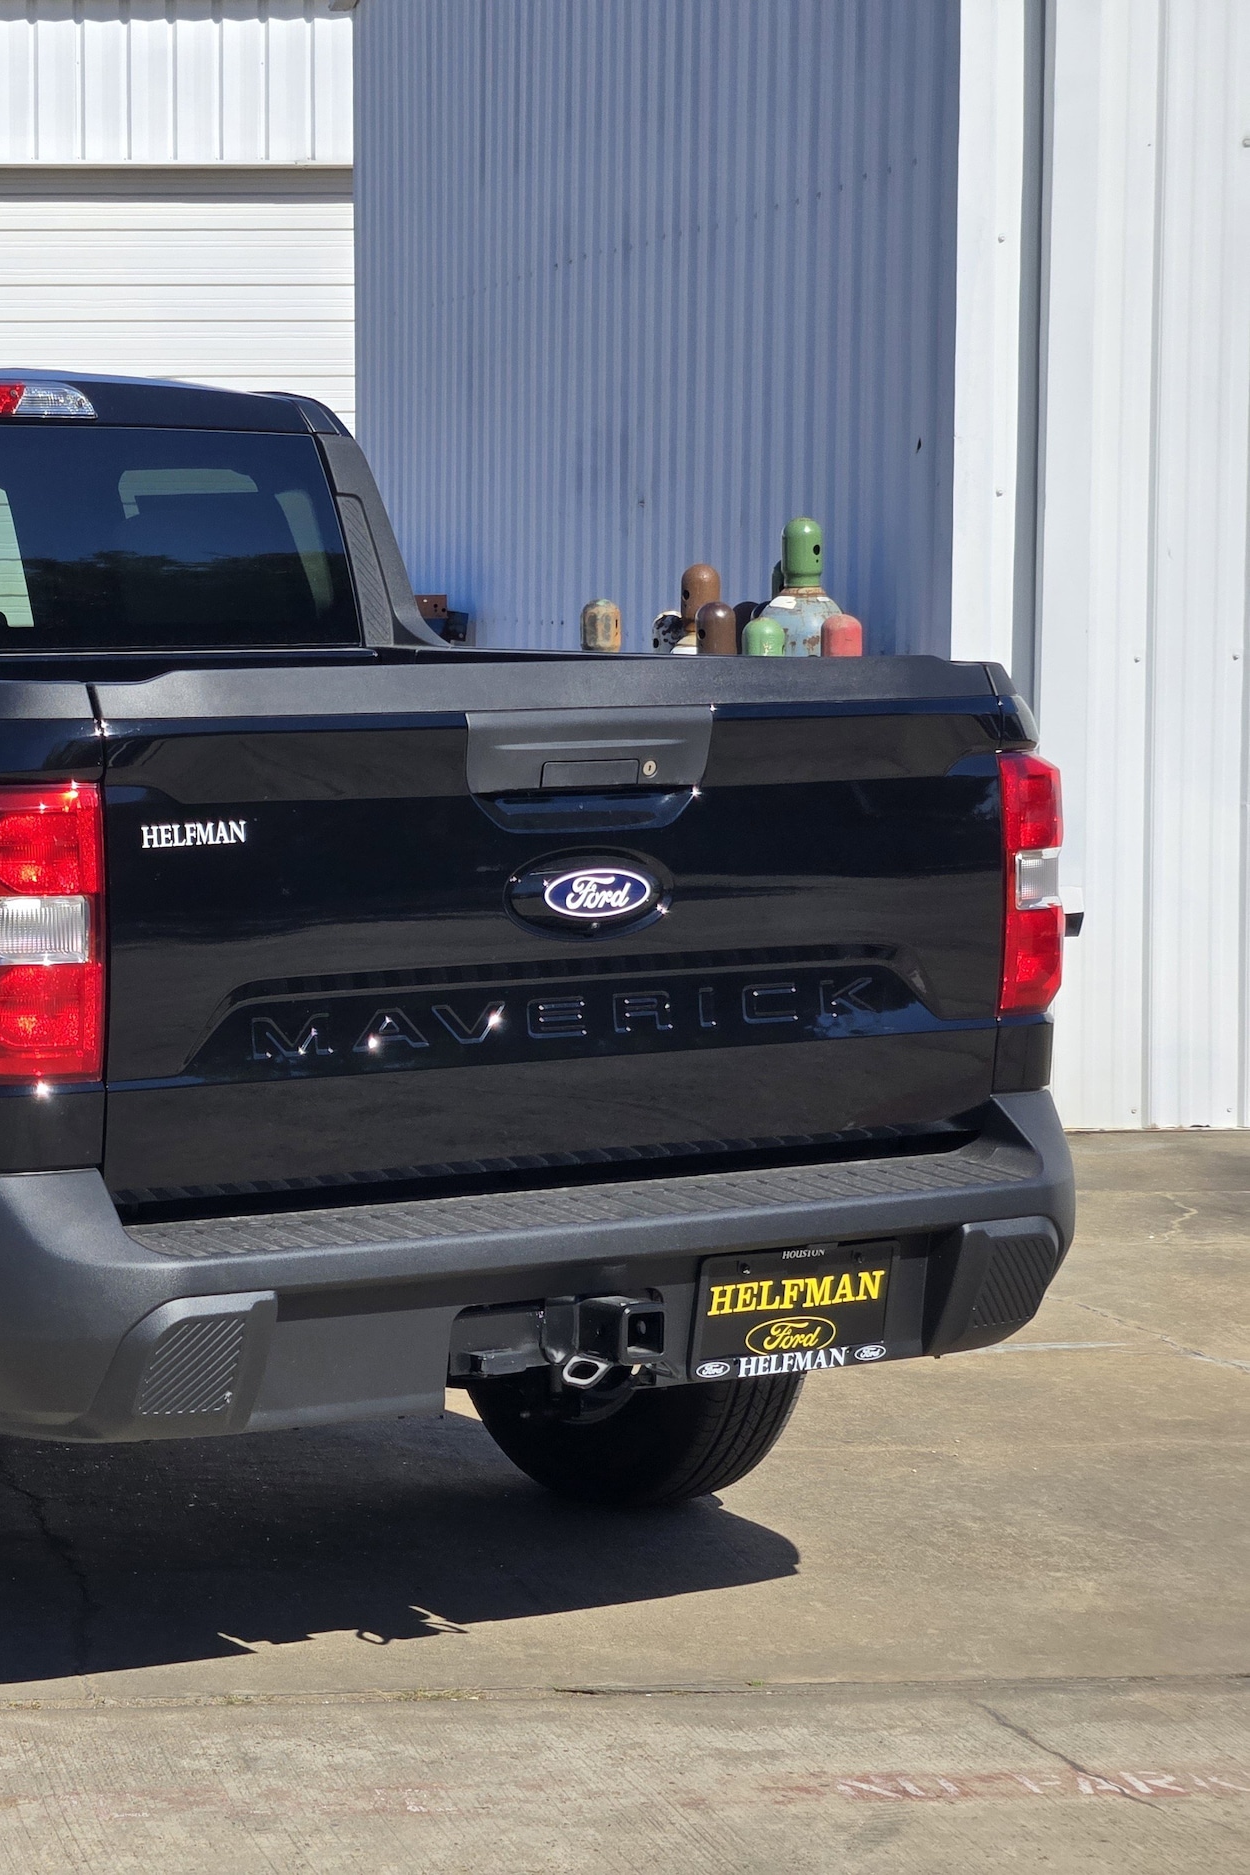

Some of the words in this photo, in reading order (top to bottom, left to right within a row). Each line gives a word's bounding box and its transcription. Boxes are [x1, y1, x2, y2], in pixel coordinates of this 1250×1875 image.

[140, 820, 246, 848] HELFMAN
[566, 876, 631, 909] Ford
[251, 976, 879, 1059] MAVERICK
[781, 1249, 826, 1260] HOUSTON
[707, 1270, 885, 1317] HELFMAN
[763, 1321, 822, 1350] Ford
[737, 1347, 850, 1378] HELFMAN
